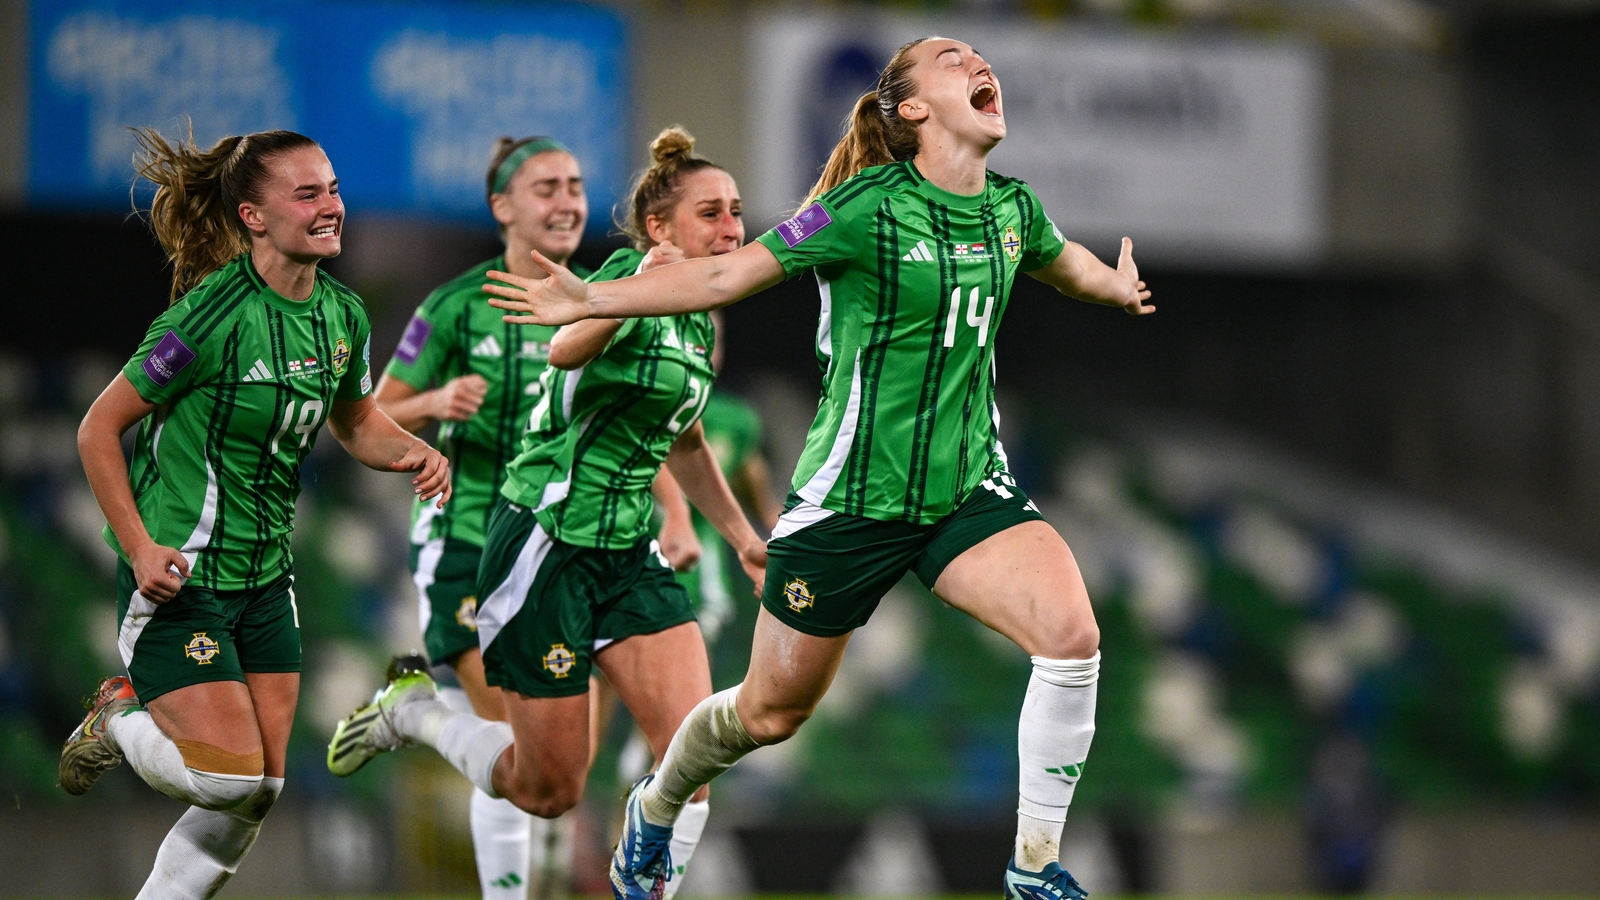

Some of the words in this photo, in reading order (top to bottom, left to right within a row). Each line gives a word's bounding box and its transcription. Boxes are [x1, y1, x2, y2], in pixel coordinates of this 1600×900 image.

[943, 286, 995, 348] 14
[152, 354, 174, 376] EUROPEAN
[270, 400, 324, 455] 19
[666, 376, 710, 435] 21
